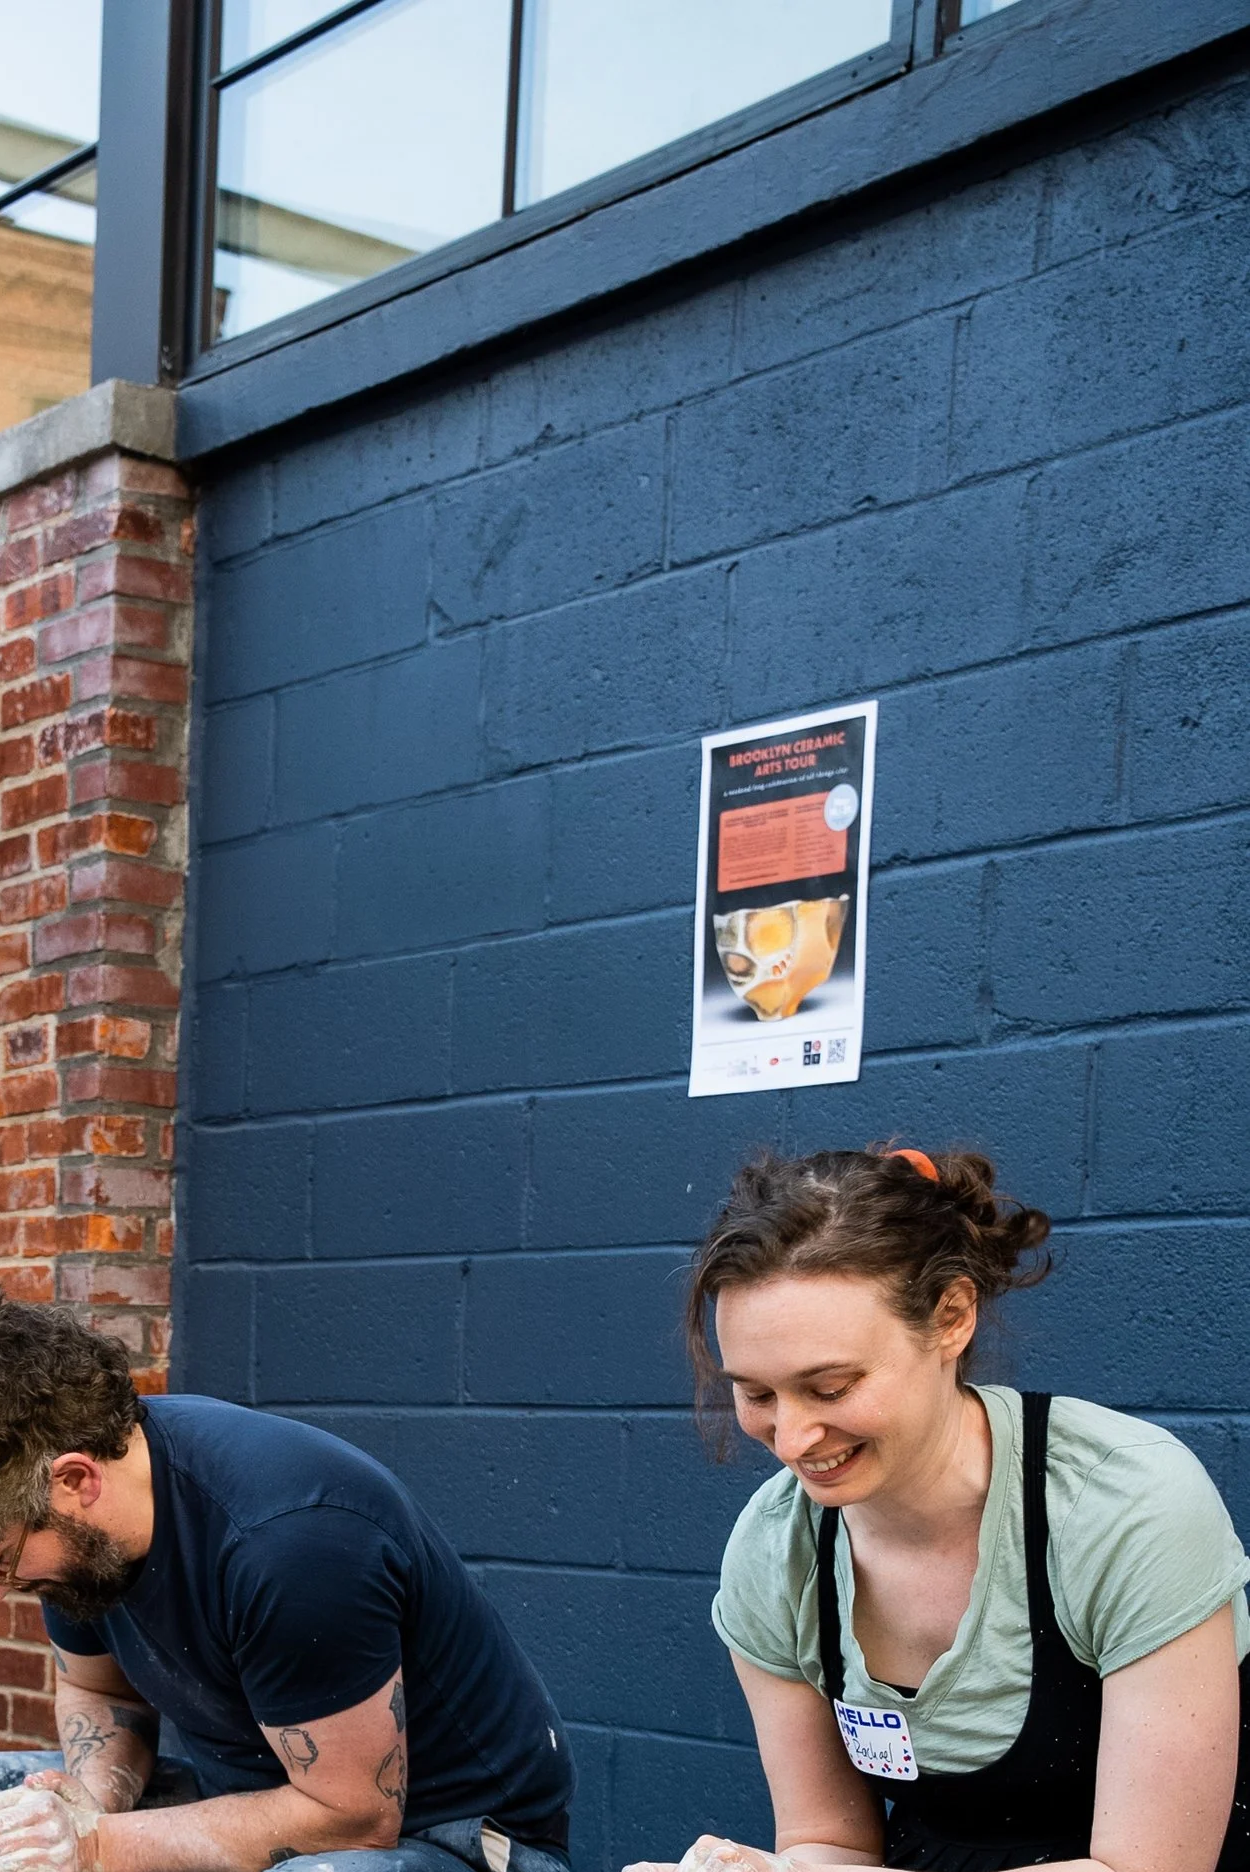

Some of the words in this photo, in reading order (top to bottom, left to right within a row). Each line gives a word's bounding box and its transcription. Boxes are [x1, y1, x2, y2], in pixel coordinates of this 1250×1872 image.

[729, 742, 792, 767] BROOKLYN
[793, 731, 846, 753] CERAMIC
[754, 761, 782, 777] ARTS
[785, 753, 817, 771] TOUR
[836, 1703, 901, 1730] HELLO
